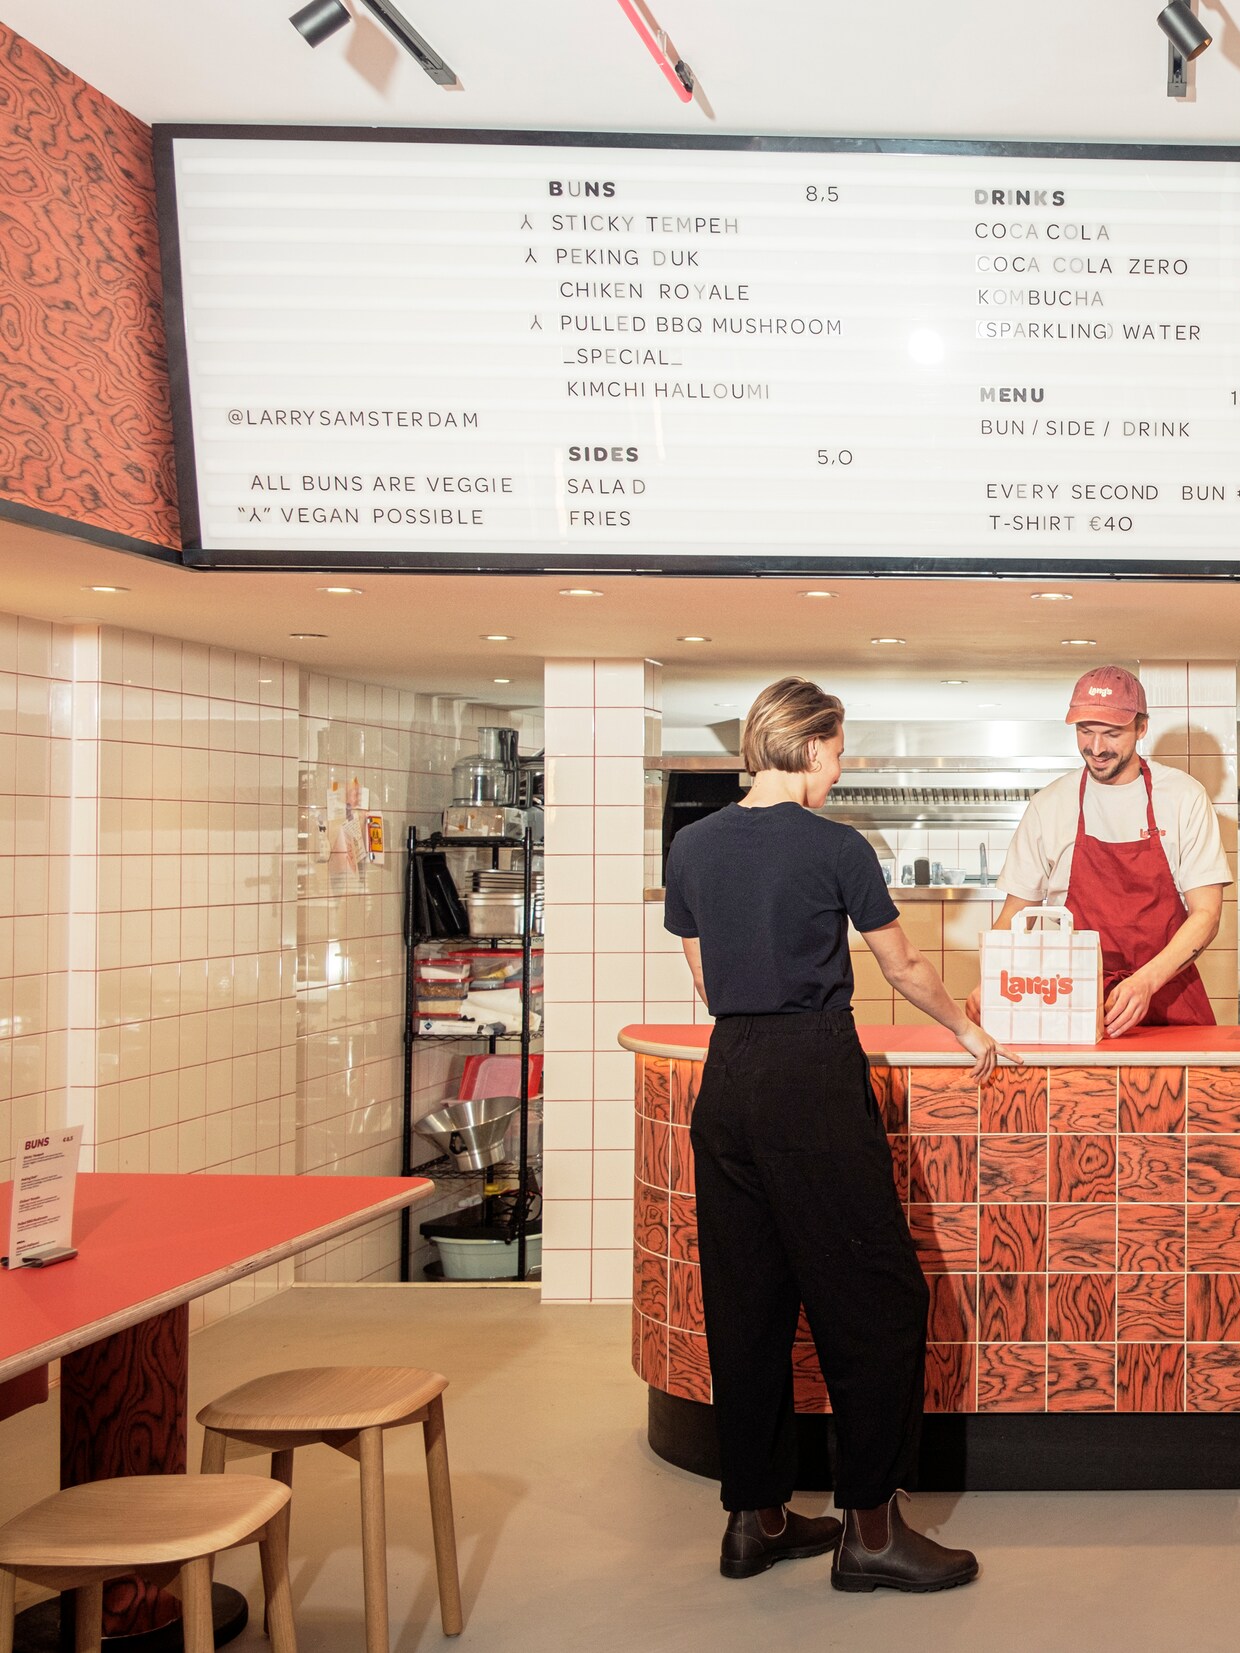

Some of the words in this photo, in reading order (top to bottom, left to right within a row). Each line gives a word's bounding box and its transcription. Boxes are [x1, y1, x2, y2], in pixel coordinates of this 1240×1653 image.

[549, 180, 616, 199] BUNS
[806, 185, 839, 203] 8,5
[975, 189, 1065, 206] DRINKS
[552, 214, 634, 232] STICKY
[646, 216, 738, 234] TEMPEH
[975, 223, 1038, 239] COCA
[1047, 224, 1109, 240] COLA
[556, 248, 639, 266] PEKING
[653, 250, 699, 266] DUK
[977, 256, 1040, 272] COCA
[1053, 257, 1112, 274] COLA
[1128, 258, 1188, 275] ZERO
[560, 282, 642, 298] CHIKEN
[660, 283, 749, 300] ROYALE
[979, 289, 1103, 306] KOMBUCHA
[561, 315, 646, 332] PULLED
[657, 317, 702, 333] BBQ
[713, 318, 841, 335] MUSHROOM
[977, 321, 1113, 339] (SPARKLING)
[1123, 324, 1200, 340] WATER
[568, 381, 644, 397] KIMCHI
[655, 382, 768, 399] HALLOUMI
[980, 387, 1044, 403] MENU
[981, 419, 1024, 435] BUN
[1046, 420, 1095, 436] SIDE
[1123, 420, 1189, 437] DRINK
[569, 446, 638, 462] SIDES
[251, 474, 291, 490] ALL
[302, 475, 363, 491] BUNS
[373, 475, 416, 492] ARE
[426, 476, 512, 493] VEGGIE
[568, 478, 645, 494] SALAD
[987, 484, 1059, 499] EVERY
[1072, 483, 1158, 500] SECOND
[1182, 485, 1224, 501] BUN
[280, 507, 359, 523] VEGAN
[372, 507, 483, 525] POSSIBLE
[570, 511, 631, 526] FRIES
[989, 515, 1075, 531] T-SHIRT
[1000, 970, 1073, 1005] Larry's
[25, 1137, 50, 1150] BUNS
